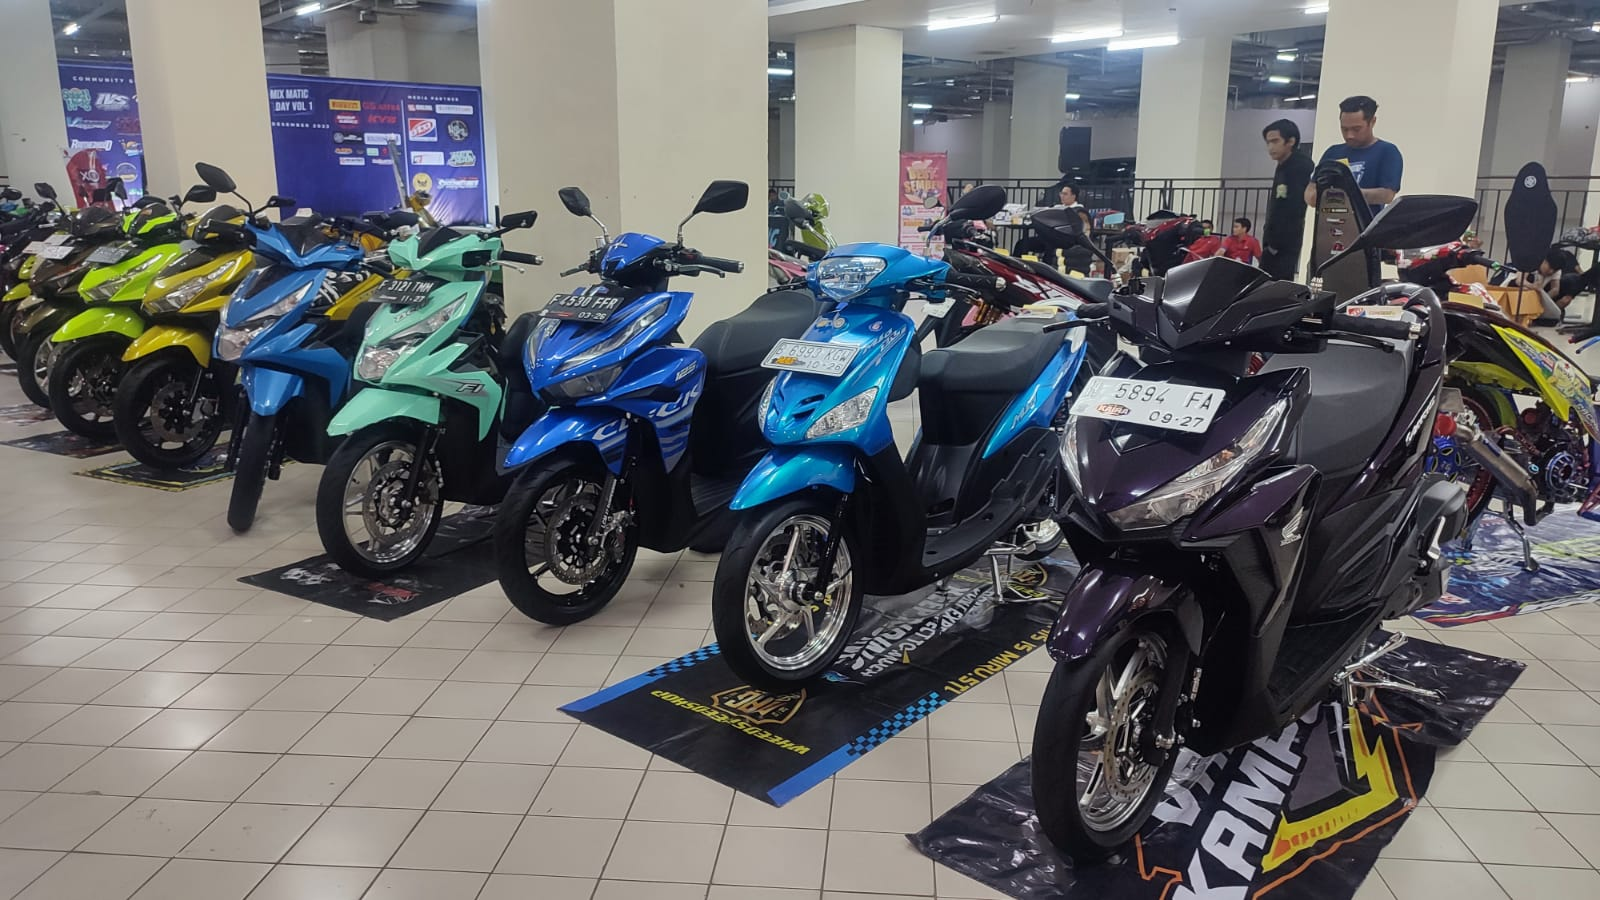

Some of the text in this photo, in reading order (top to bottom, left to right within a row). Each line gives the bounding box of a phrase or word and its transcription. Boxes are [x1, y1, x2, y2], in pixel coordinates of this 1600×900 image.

[270, 89, 309, 99] MIX MATIC
[275, 101, 313, 111] DAY VOL 1
[378, 280, 389, 290] F
[388, 280, 412, 292] 3121
[549, 294, 618, 310] F 4530 FFR
[788, 345, 822, 359] 6993
[675, 361, 697, 382] 125
[456, 383, 485, 394] FI
[1115, 383, 1170, 404] 5894
[1184, 391, 1214, 411] FA
[1014, 641, 1037, 652] IS
